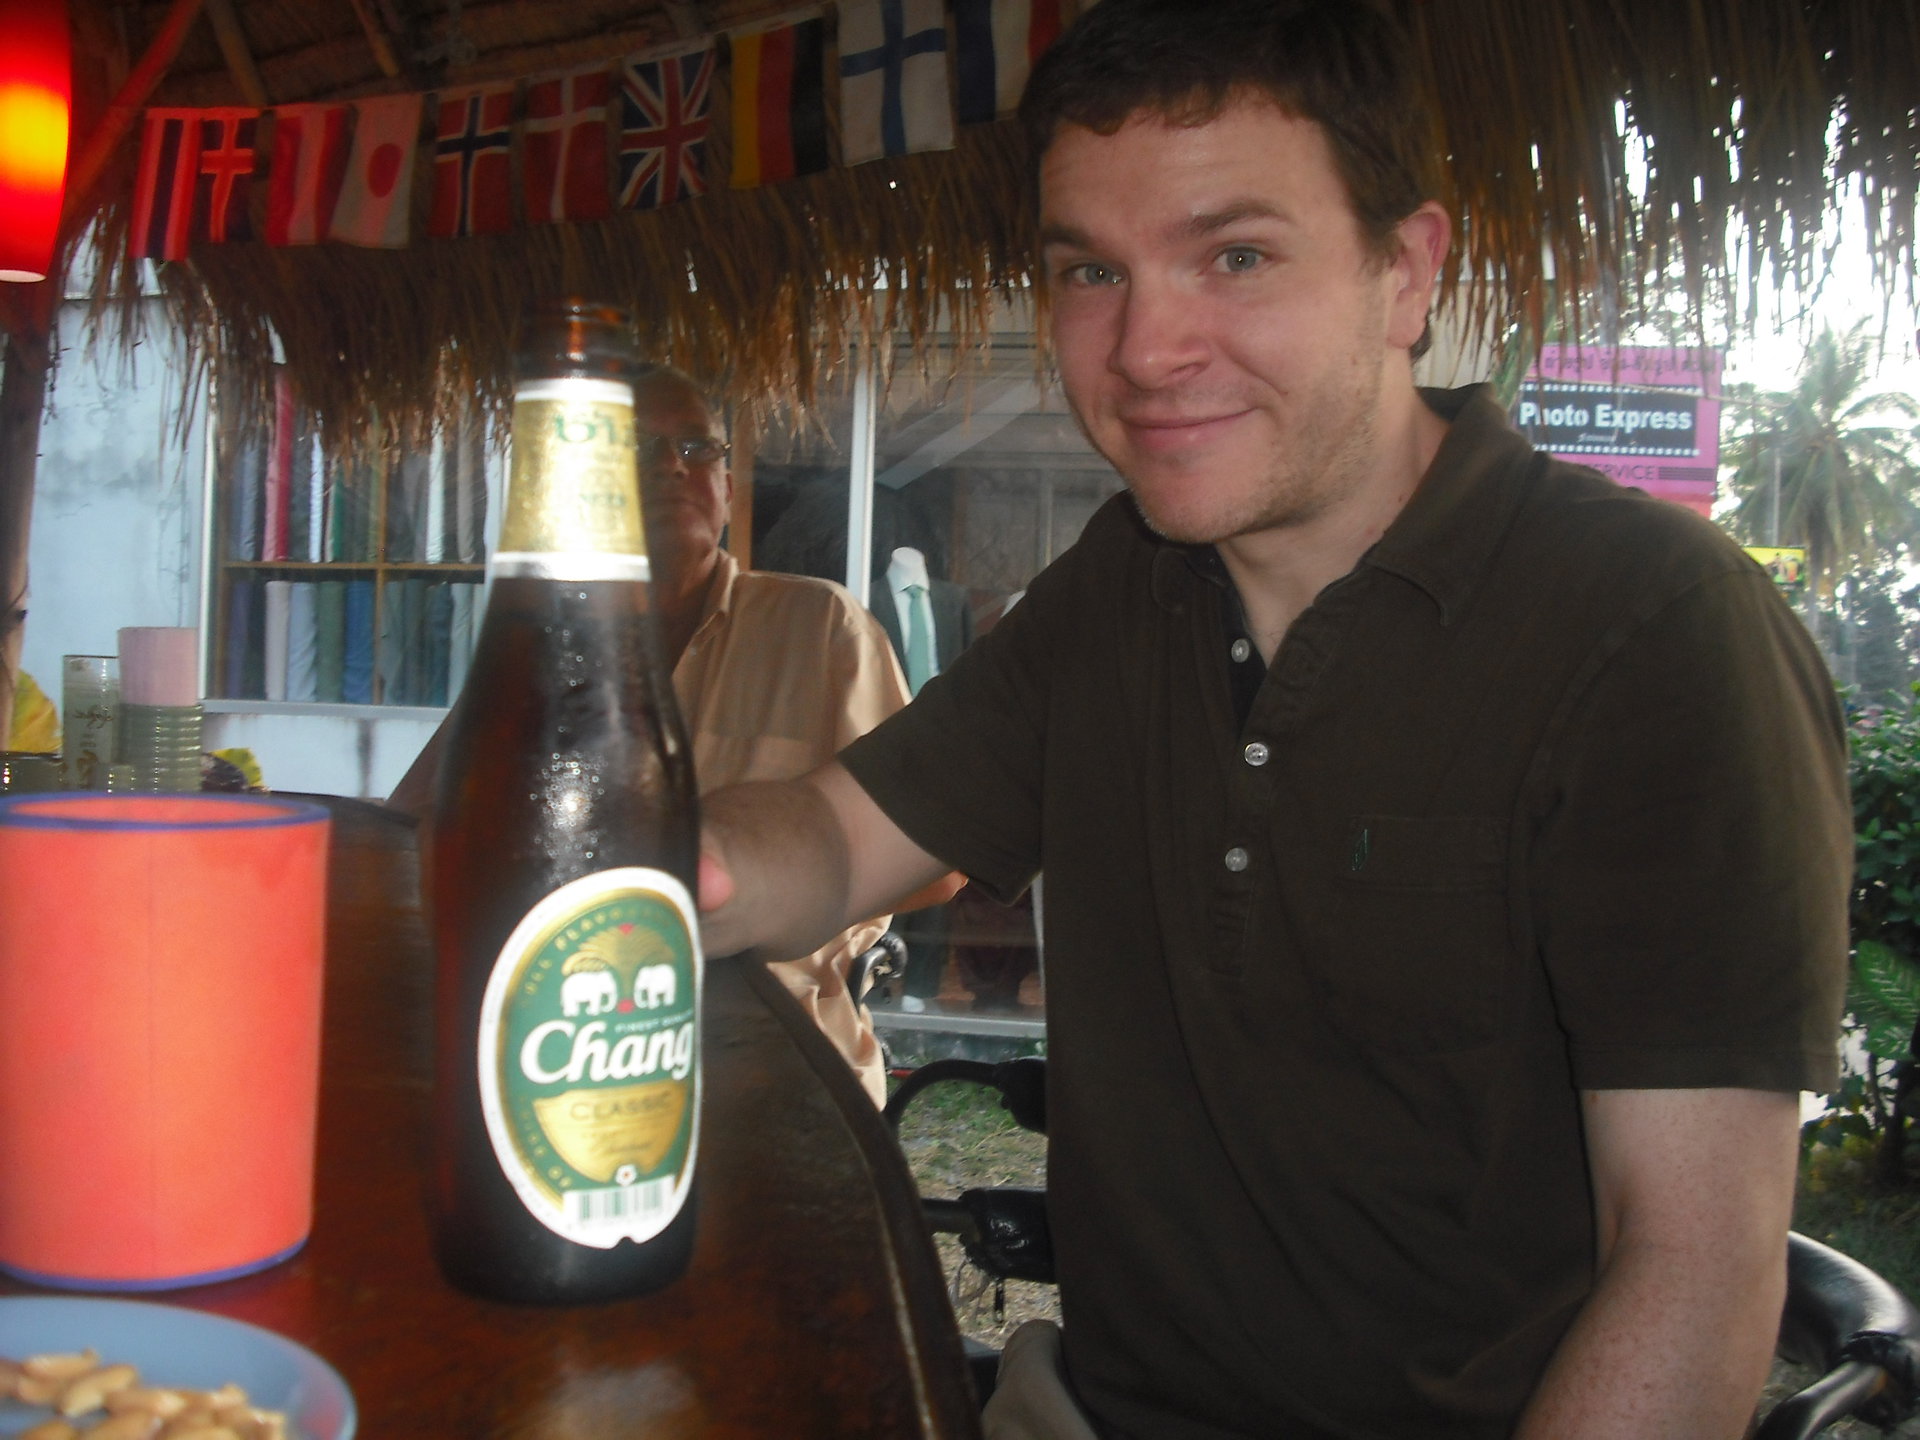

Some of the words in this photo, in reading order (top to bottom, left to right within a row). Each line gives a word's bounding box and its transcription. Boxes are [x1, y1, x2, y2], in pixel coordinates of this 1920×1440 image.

[1595, 403, 1692, 434] Express
[520, 1019, 694, 1084] Chang
[570, 1090, 671, 1122] CLASSIC
